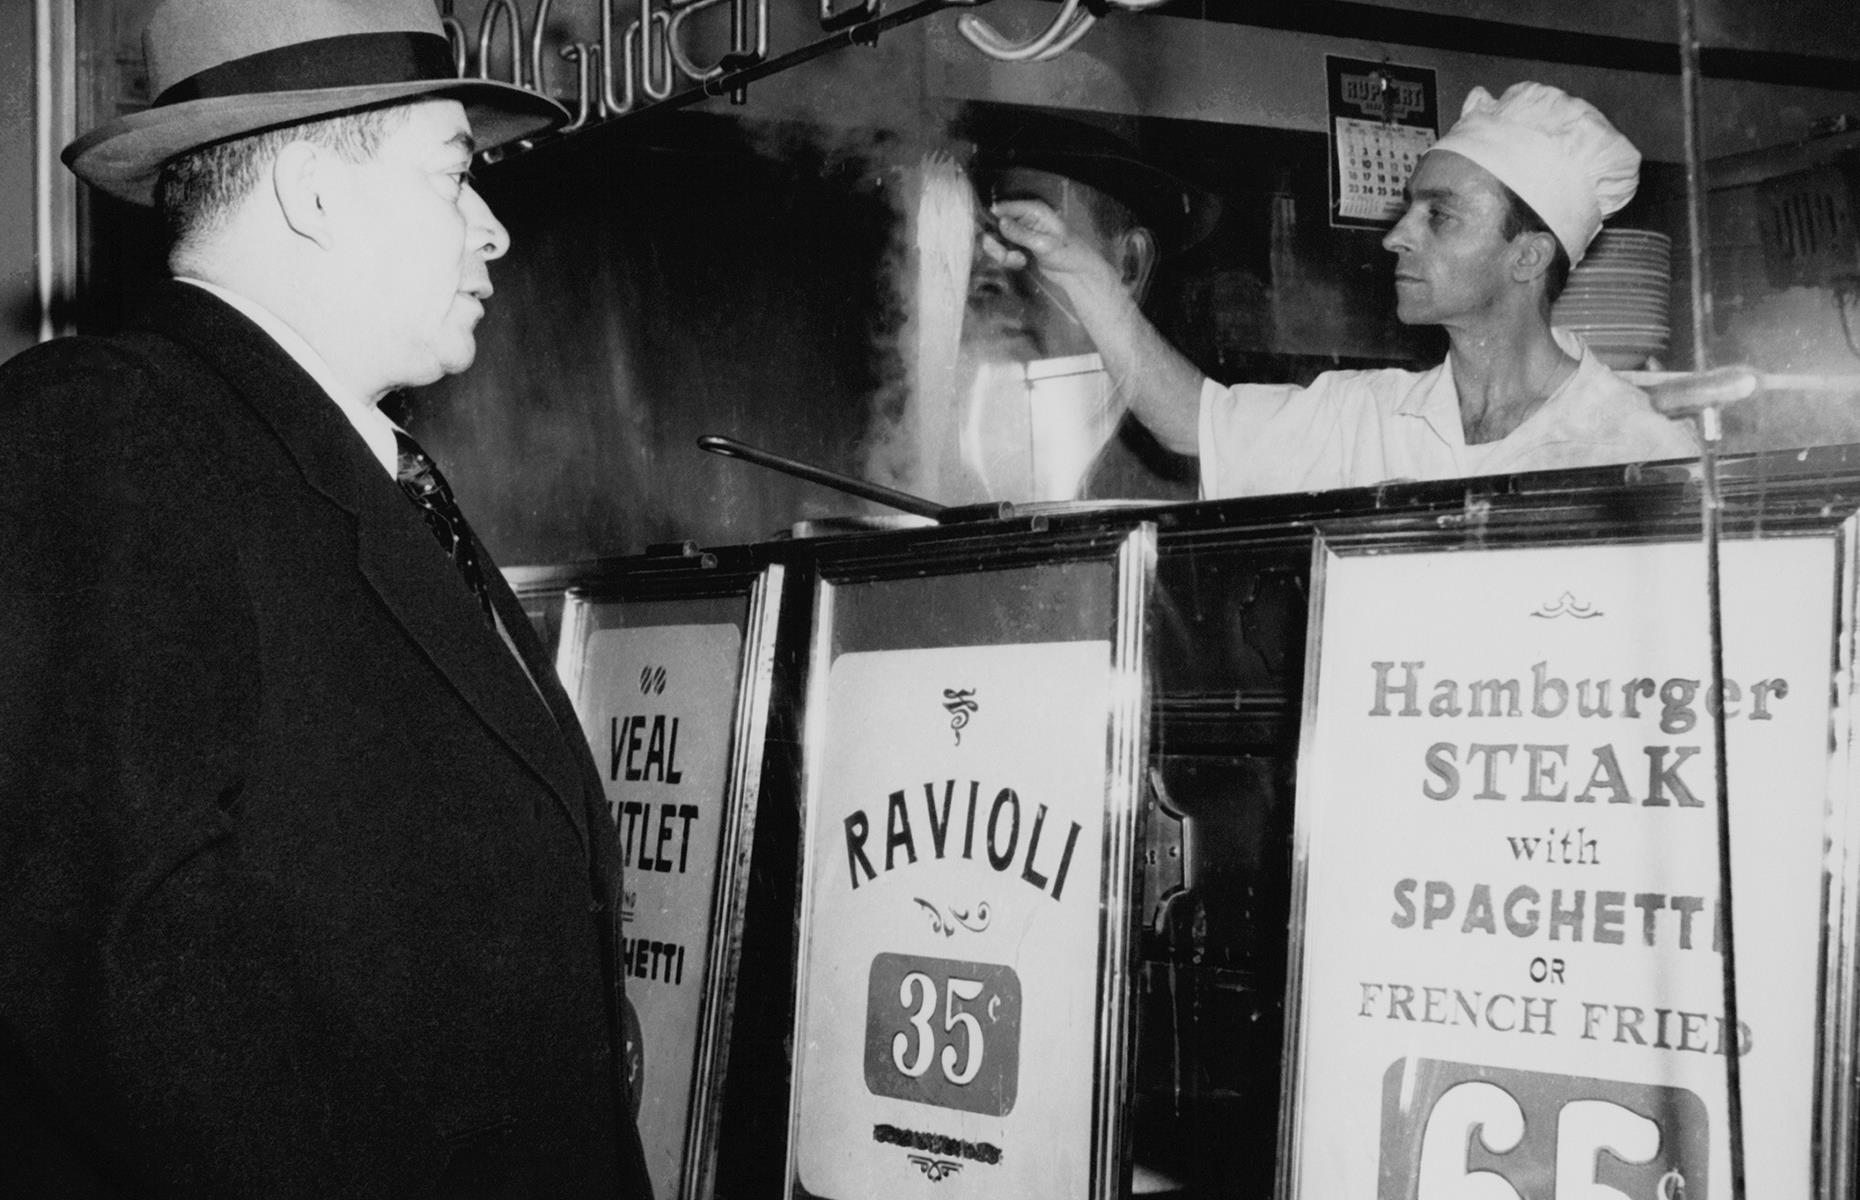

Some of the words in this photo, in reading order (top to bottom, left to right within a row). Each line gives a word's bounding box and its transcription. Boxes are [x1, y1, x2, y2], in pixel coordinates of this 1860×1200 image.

[1368, 661, 1789, 734] Hamburger
[611, 715, 682, 784] VEAL
[1422, 742, 1705, 808] STEAK
[844, 779, 1082, 901] RAVIOLI
[1507, 827, 1600, 865] with
[1529, 957, 1565, 985] OR
[1358, 982, 1557, 1036] FRENCH
[1581, 1002, 1753, 1057] FRIED
